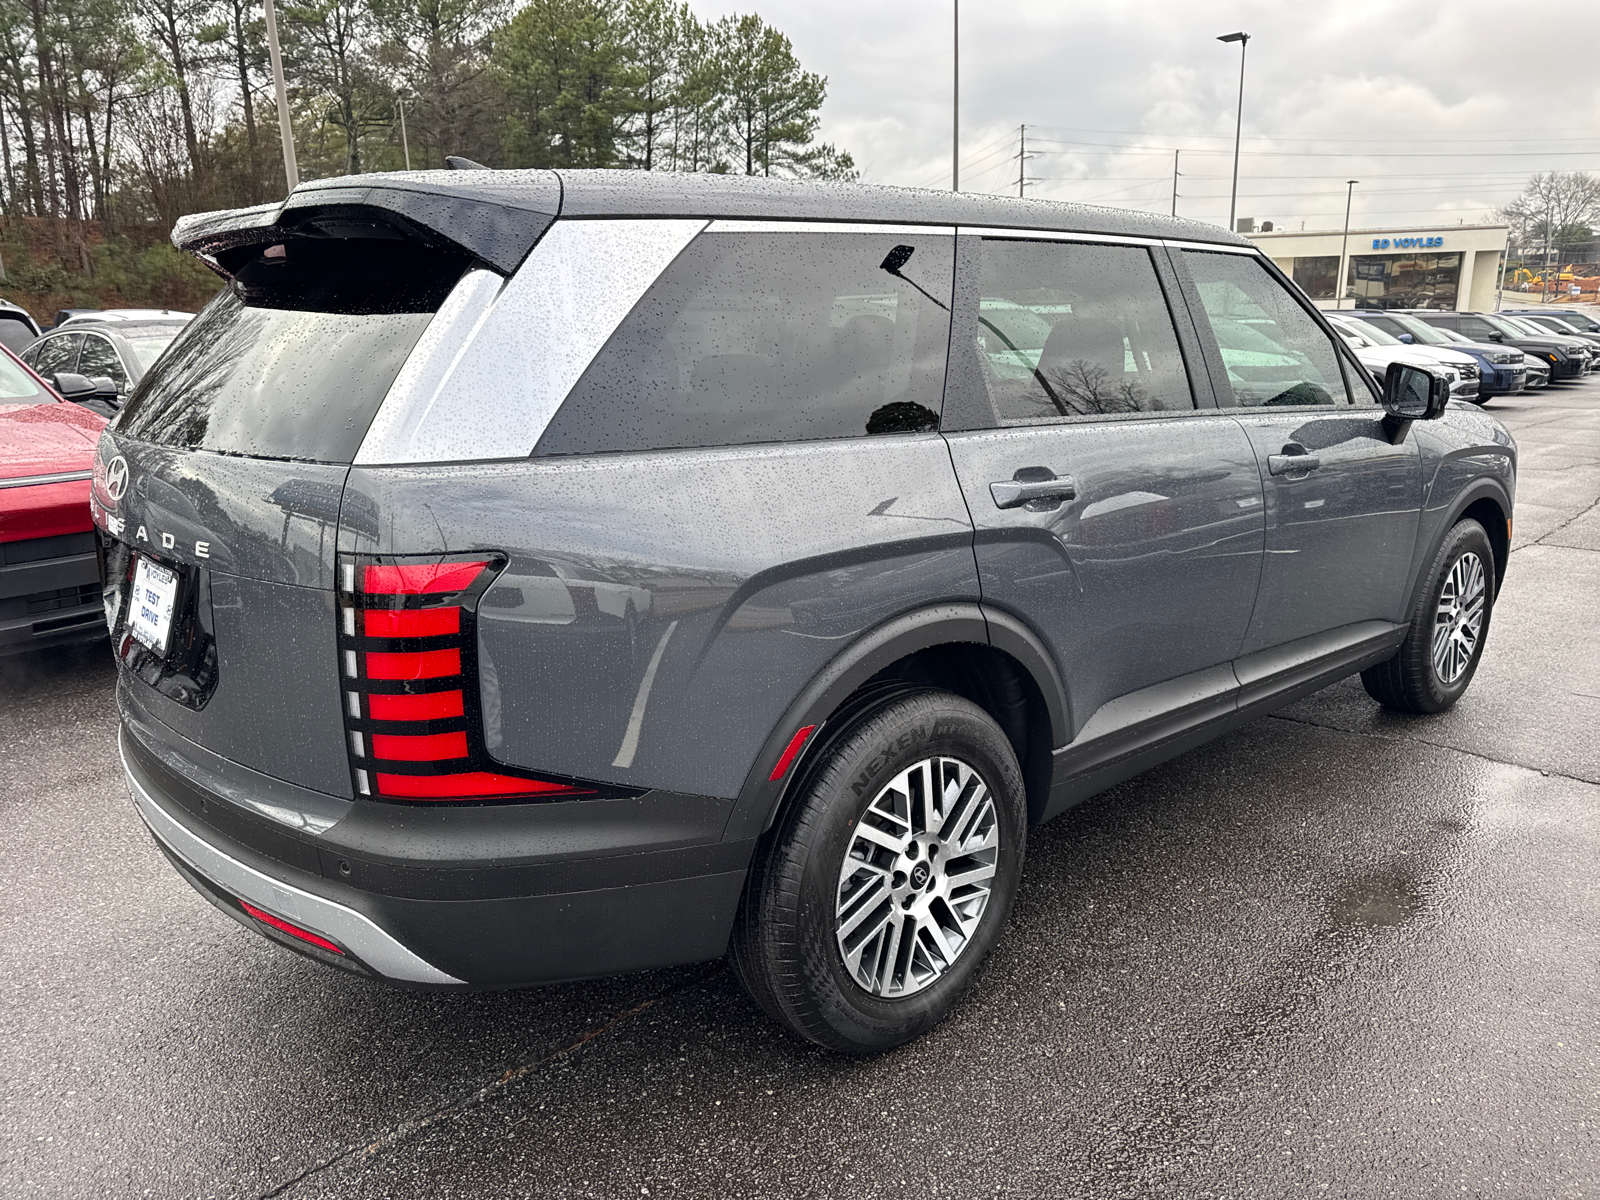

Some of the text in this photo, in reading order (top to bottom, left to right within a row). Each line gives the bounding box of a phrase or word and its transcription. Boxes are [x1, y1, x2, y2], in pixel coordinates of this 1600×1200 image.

[1373, 236, 1444, 249] ED VOYLES
[145, 588, 161, 607] TEST
[141, 605, 160, 627] DRIVE
[851, 723, 926, 797] NEXEN
